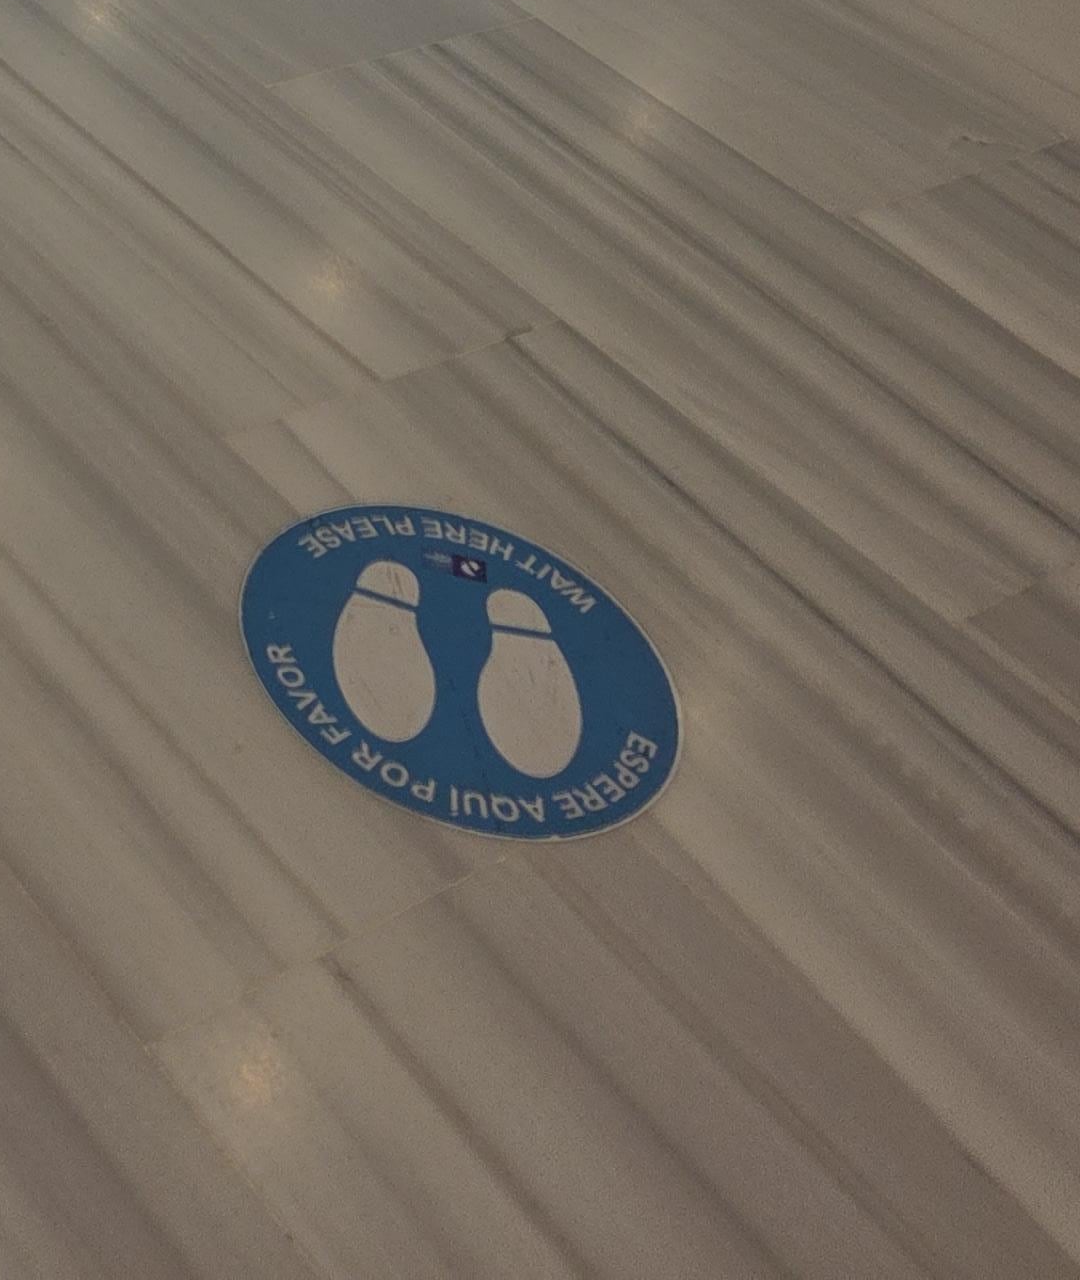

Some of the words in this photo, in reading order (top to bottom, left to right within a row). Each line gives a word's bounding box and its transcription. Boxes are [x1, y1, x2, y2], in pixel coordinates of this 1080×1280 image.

[298, 513, 417, 559] PLEASE
[420, 519, 514, 561] HERE
[515, 554, 598, 614] WAIT
[266, 642, 353, 746] FAVOR
[351, 739, 438, 803] POR
[552, 730, 658, 821] ESPERE
